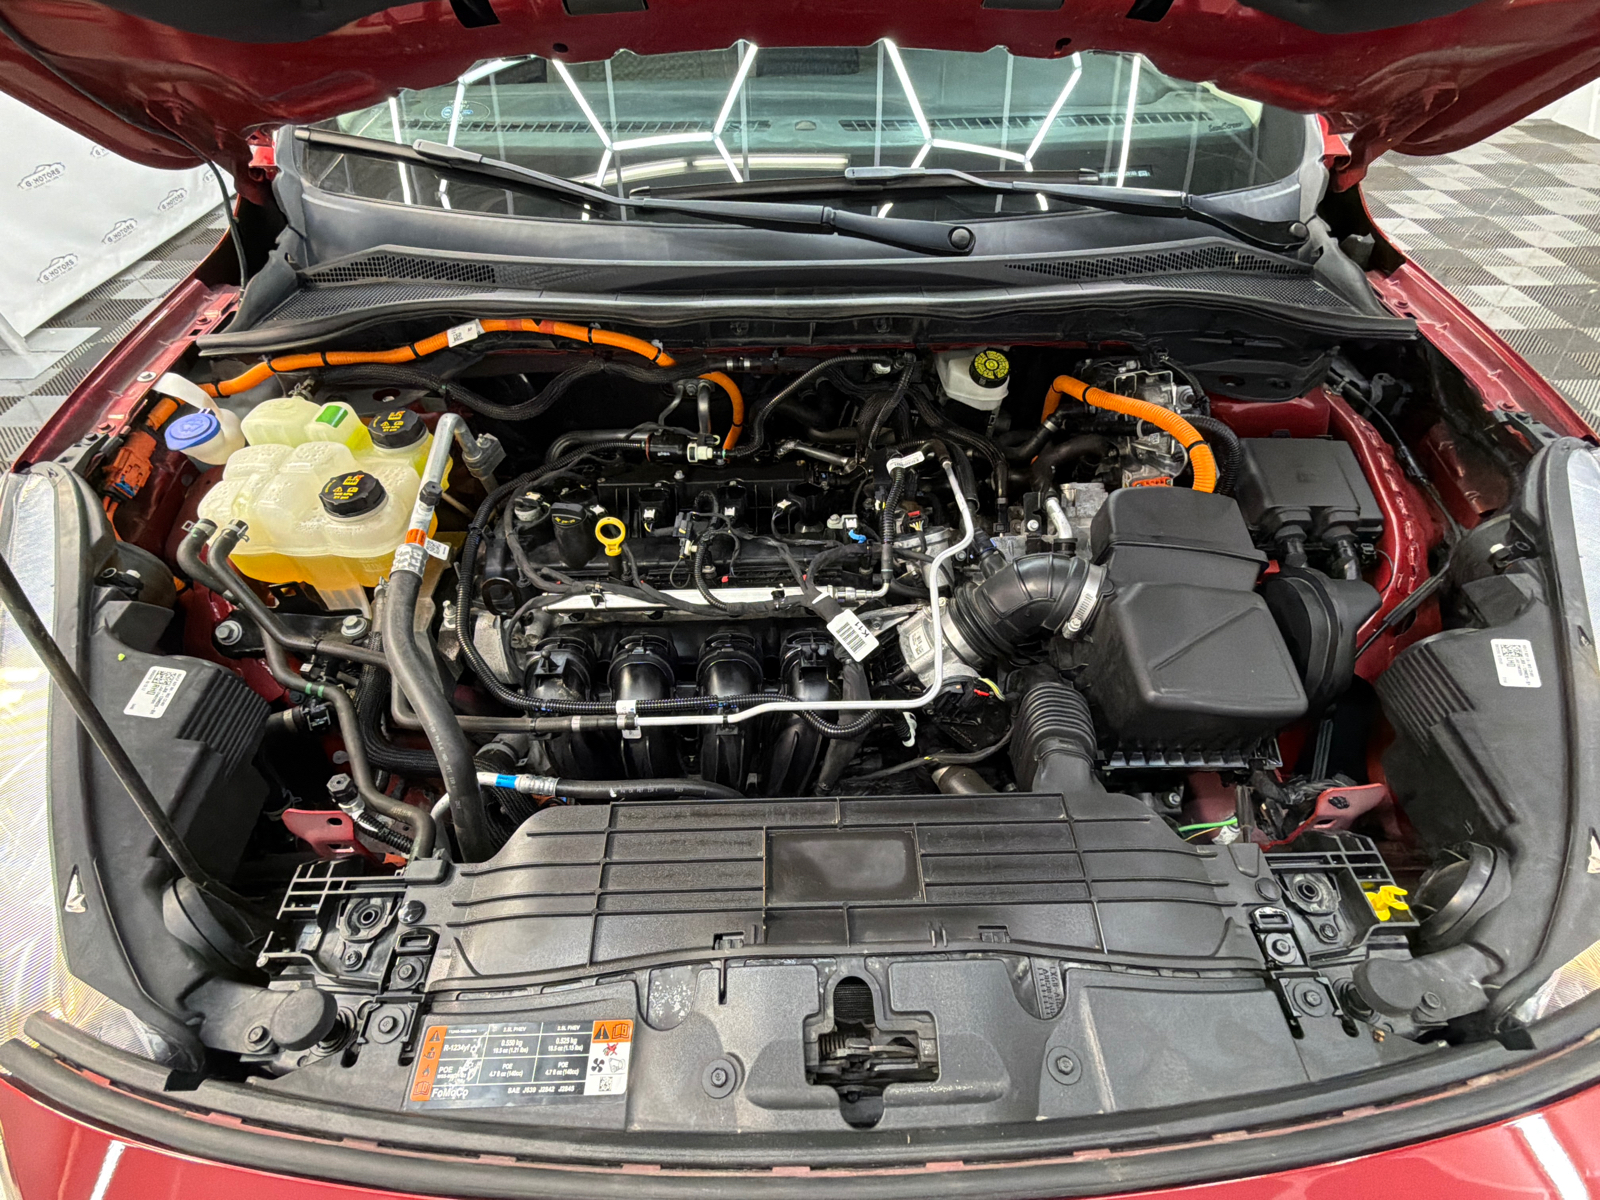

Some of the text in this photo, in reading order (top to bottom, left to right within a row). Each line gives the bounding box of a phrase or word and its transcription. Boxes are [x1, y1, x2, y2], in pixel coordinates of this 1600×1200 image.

[516, 1039, 523, 1048] kg
[570, 1037, 578, 1046] kg
[443, 1044, 470, 1052] R-1234yf
